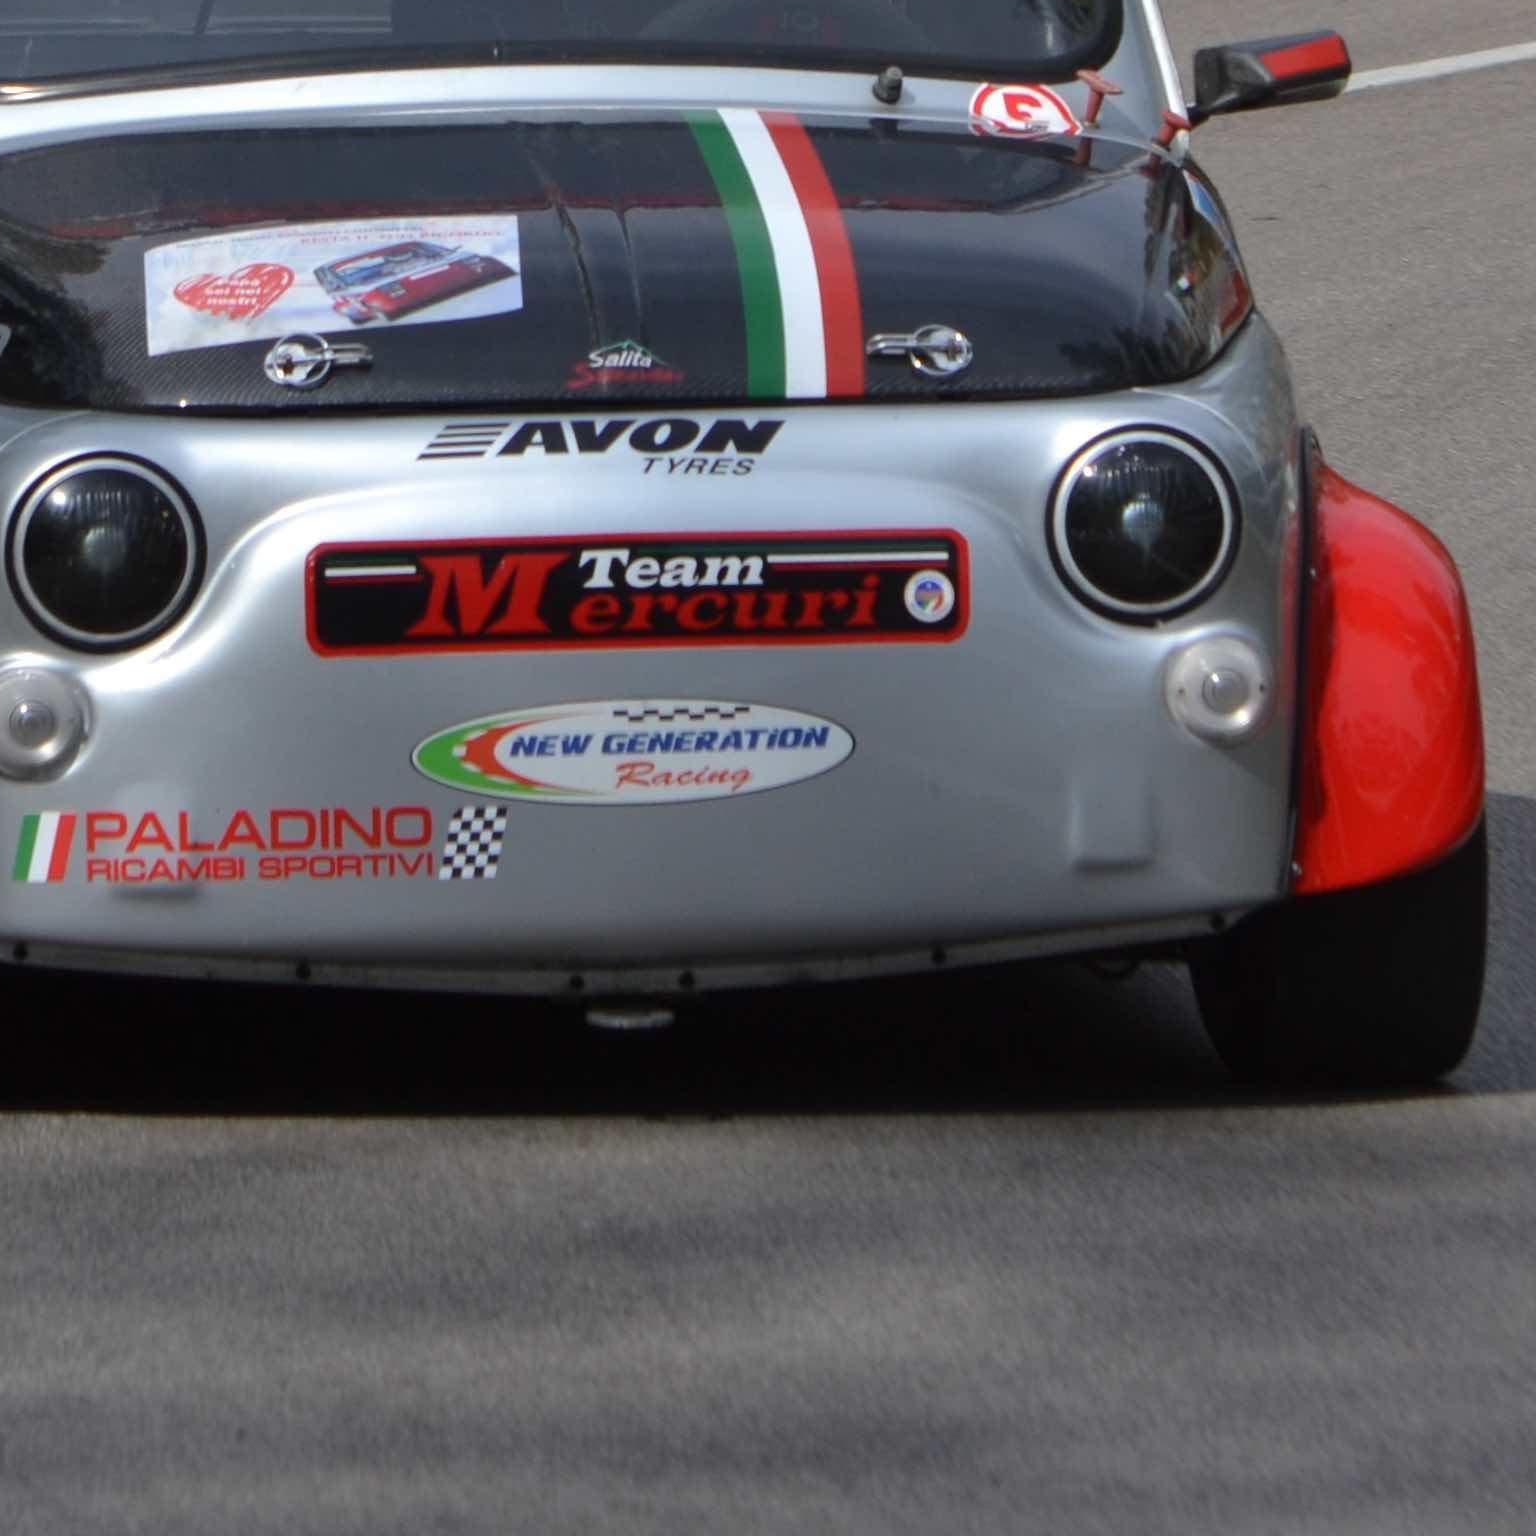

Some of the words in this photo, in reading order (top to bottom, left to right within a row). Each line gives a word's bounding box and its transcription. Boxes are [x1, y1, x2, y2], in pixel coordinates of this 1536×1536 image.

[588, 349, 653, 368] Salita
[496, 419, 785, 456] AVON
[643, 458, 755, 476] TYRES
[579, 549, 765, 589] Team
[406, 552, 878, 636] Mercuri
[510, 731, 590, 758] NEW
[615, 761, 752, 792] Racing
[85, 807, 433, 852] PALADINO
[85, 857, 246, 882] RICAMBI
[258, 853, 433, 879] SPORTIVI
